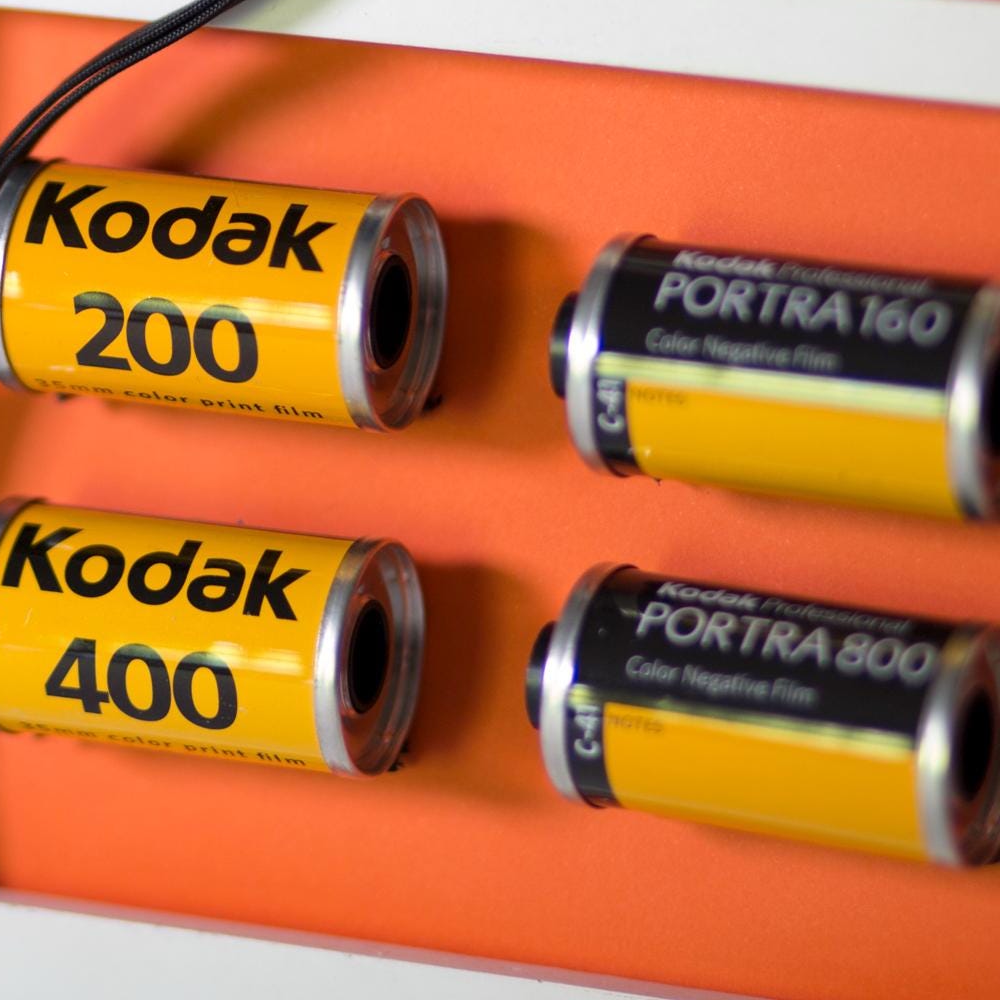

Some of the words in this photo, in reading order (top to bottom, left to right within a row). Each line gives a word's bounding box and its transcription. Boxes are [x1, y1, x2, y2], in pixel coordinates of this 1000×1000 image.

[24, 180, 337, 273] Kodak
[672, 249, 777, 280] Kodak
[72, 291, 259, 384] 200
[652, 270, 852, 337] PORTRA
[858, 294, 953, 348] 160
[645, 326, 700, 352] Color
[702, 332, 792, 365] Negative
[793, 344, 842, 372] Film
[123, 388, 188, 404] color
[199, 398, 265, 413] print
[273, 404, 325, 420] film
[1, 521, 310, 622] Kodak
[656, 581, 761, 612] Kodak
[636, 601, 833, 669] PORTRA
[834, 632, 937, 686] 800
[45, 637, 238, 730] 400
[625, 655, 679, 682] Color
[680, 663, 768, 698] Negative
[770, 677, 820, 704] Film
[106, 732, 172, 748] color
[183, 742, 248, 759] print
[255, 750, 307, 767] film
